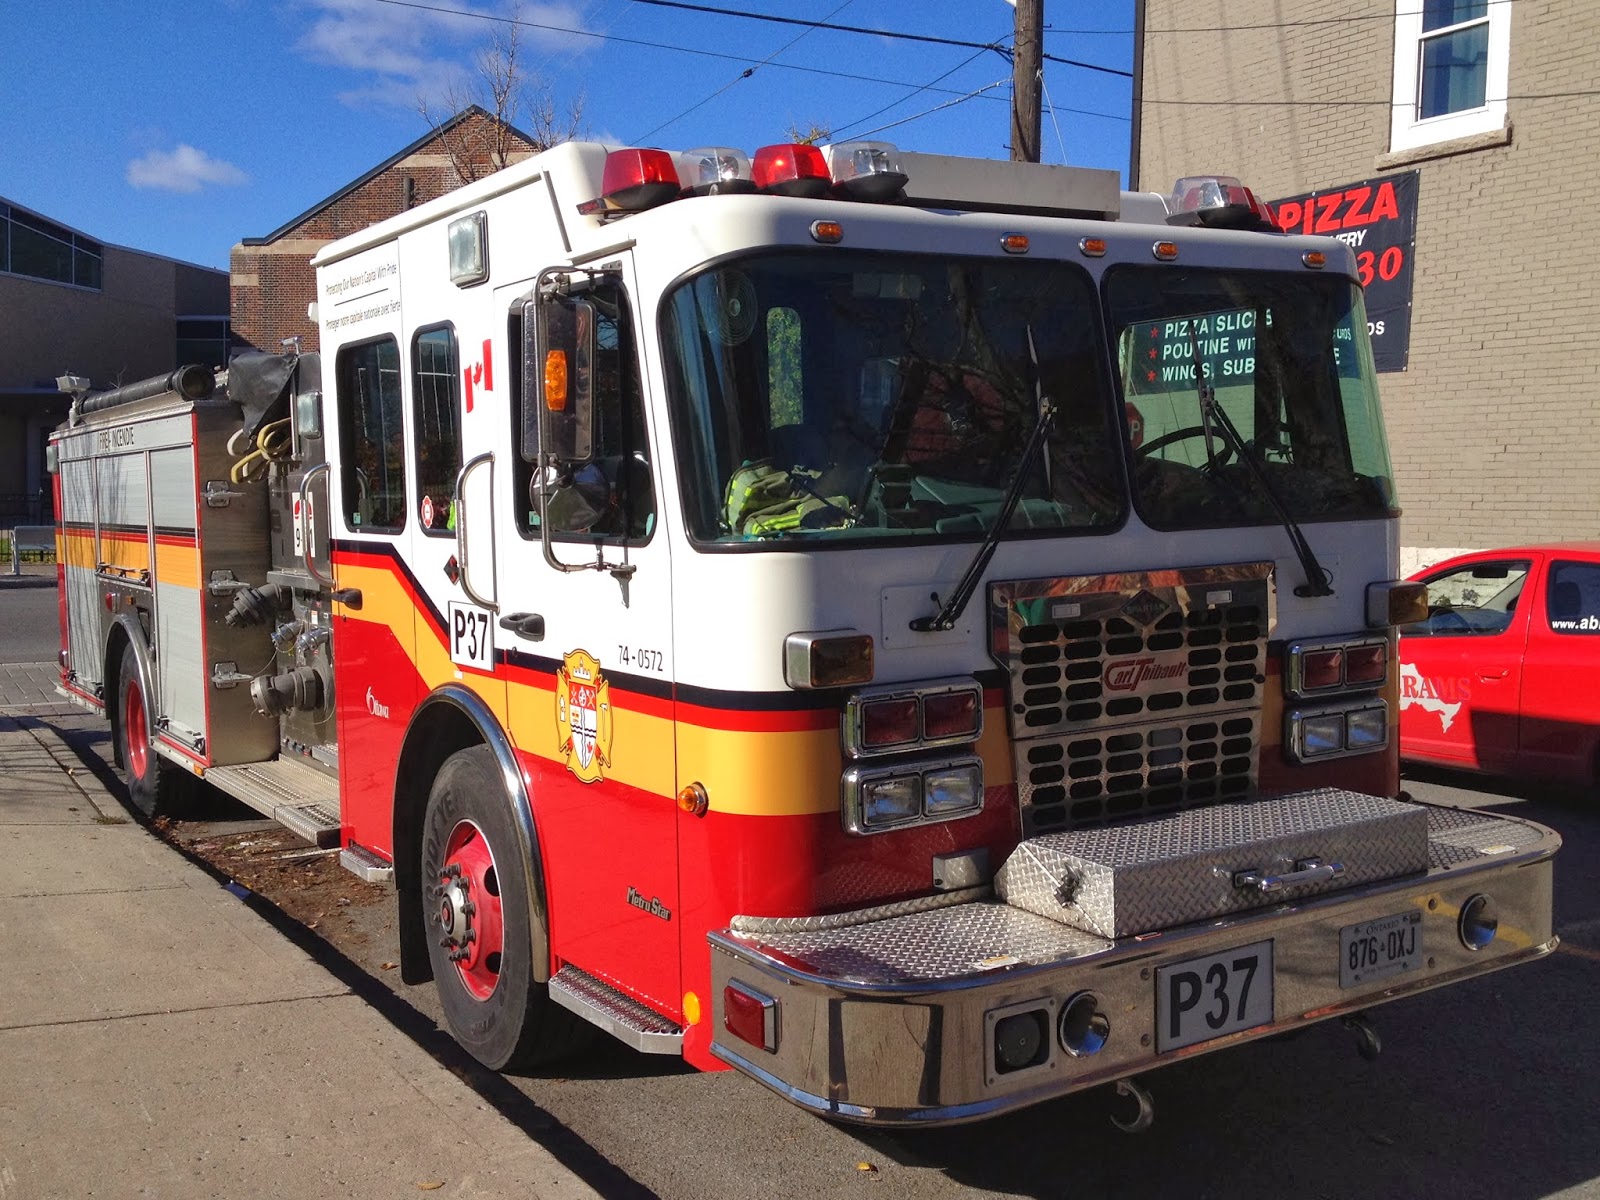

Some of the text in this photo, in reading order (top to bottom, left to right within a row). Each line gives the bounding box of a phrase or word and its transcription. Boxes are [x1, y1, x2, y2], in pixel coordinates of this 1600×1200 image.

[1278, 182, 1399, 236] PIZZA
[1357, 246, 1403, 287] 30
[1216, 308, 1273, 332] SLICS
[454, 609, 489, 661] P37
[1552, 614, 1600, 630] www.ab
[618, 645, 664, 672] 74-0572
[1130, 658, 1188, 692] Thibault
[366, 686, 390, 719] Ottawa
[1366, 919, 1400, 936] ONTARIO
[1349, 936, 1378, 970] 876
[1169, 955, 1259, 1040] P37
